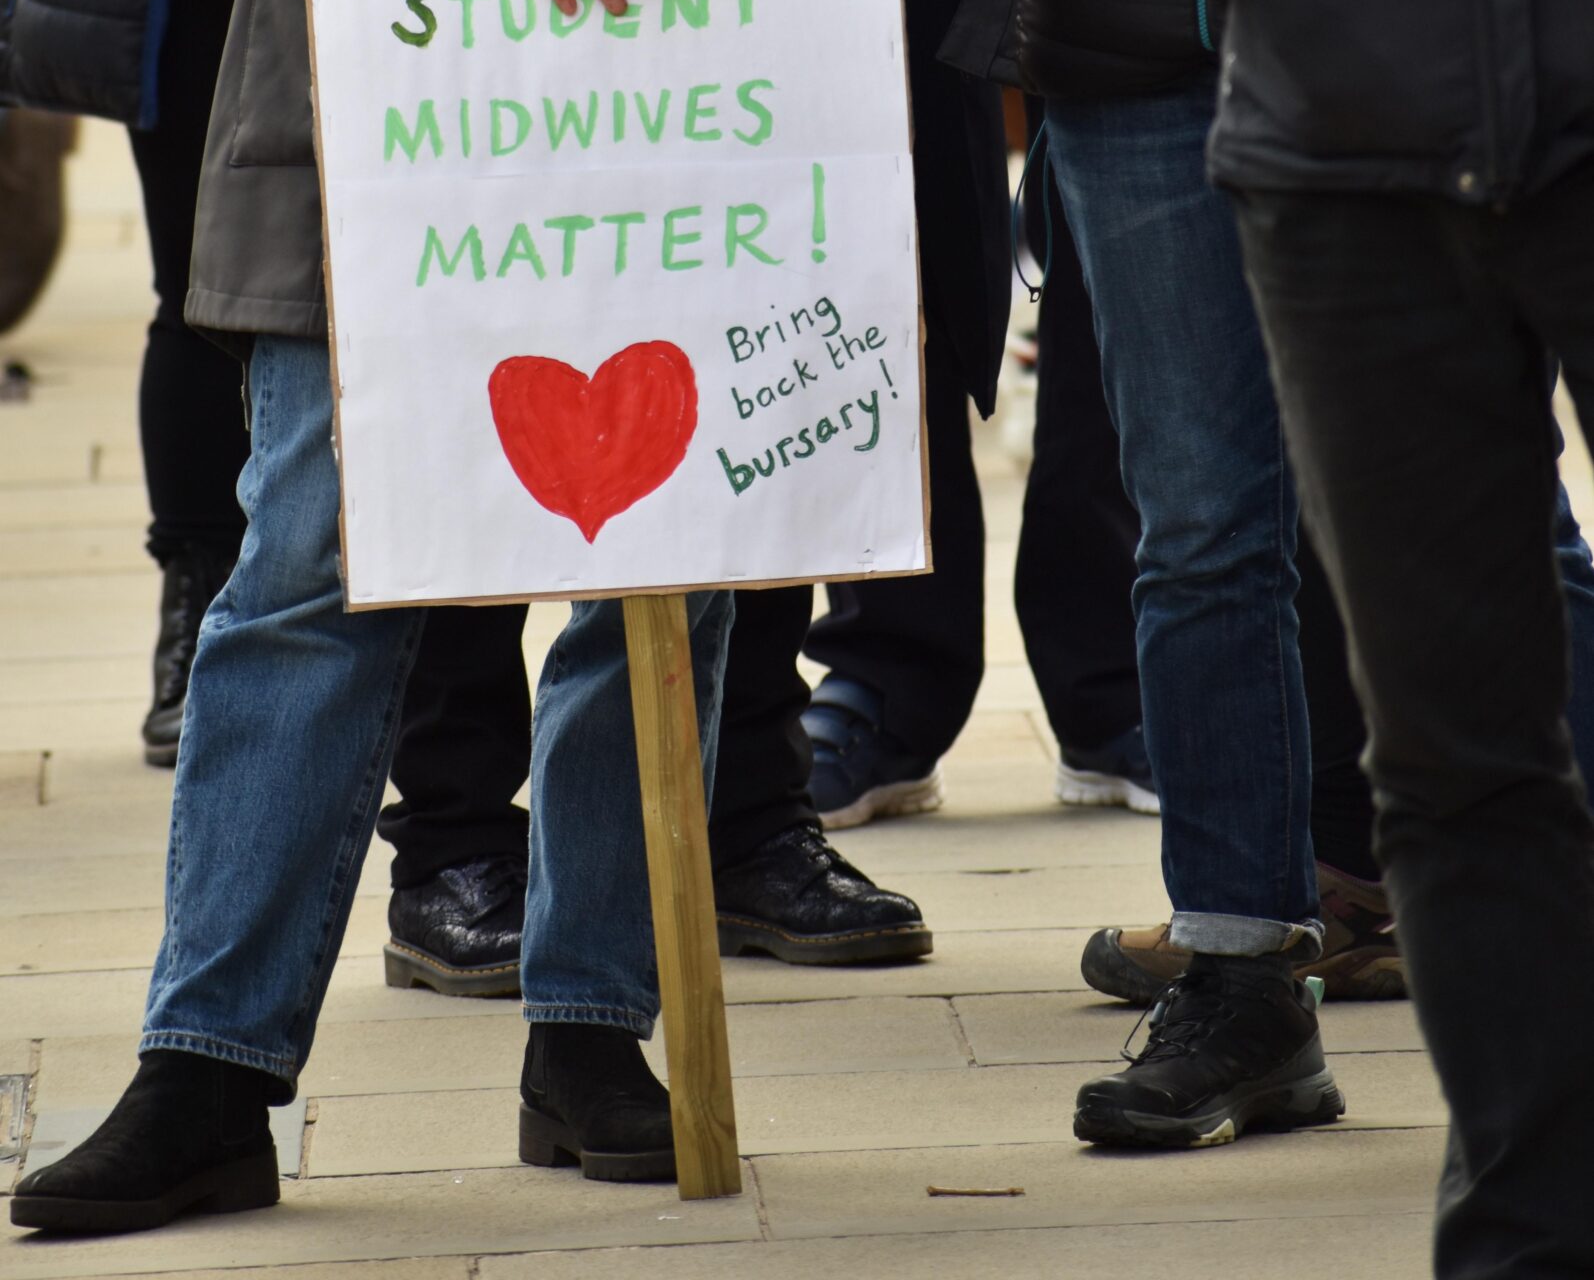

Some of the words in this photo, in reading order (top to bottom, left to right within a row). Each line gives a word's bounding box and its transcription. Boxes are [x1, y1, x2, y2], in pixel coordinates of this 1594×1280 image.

[383, 78, 777, 164] MIDWIVES
[725, 296, 842, 364] Bring
[730, 358, 819, 420] back
[824, 325, 888, 371] the
[715, 357, 899, 497] bursary!
